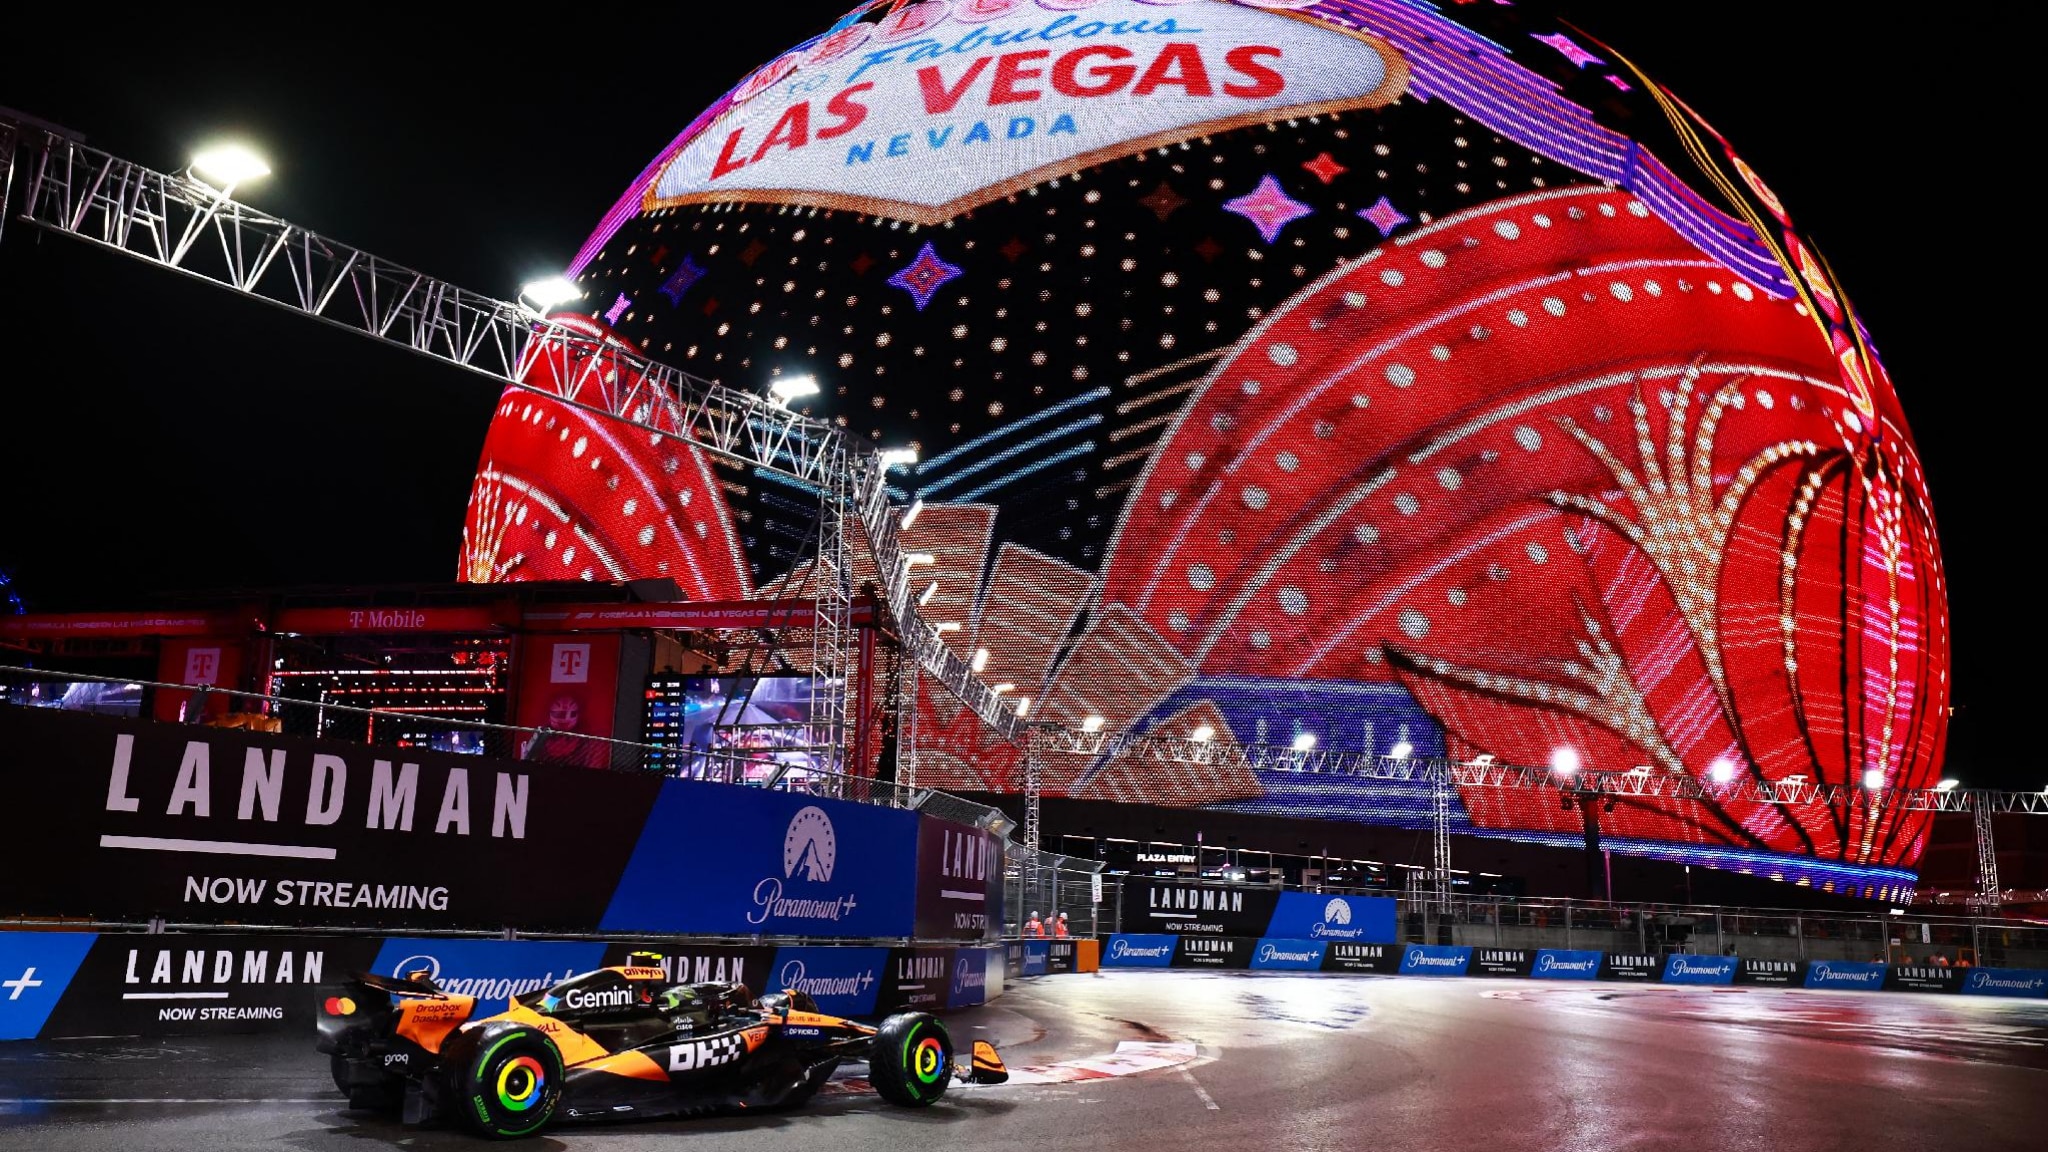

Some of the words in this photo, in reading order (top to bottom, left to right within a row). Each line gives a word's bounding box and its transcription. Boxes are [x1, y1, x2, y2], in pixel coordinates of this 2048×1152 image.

[845, 14, 1201, 84] Fabulous
[708, 81, 874, 181] LAS
[915, 42, 1286, 115] VEGAS
[844, 112, 1078, 166] NEVADA
[368, 608, 425, 629] Mobile
[701, 610, 720, 618] LAS
[721, 609, 756, 618] VEGAS
[106, 734, 529, 839] LANDMAN
[1136, 853, 1166, 863] PLAZA
[1167, 854, 1196, 864] ENTRY
[184, 876, 267, 905] NOW
[274, 879, 449, 911] STREAMING
[747, 877, 856, 924] Paramount+
[1150, 887, 1242, 912] LANDMAN
[1166, 922, 1183, 931] NOW
[1184, 923, 1224, 932] STREAMING
[1310, 922, 1364, 938] Paramount+
[1185, 940, 1233, 952] LANDMAN
[1259, 944, 1320, 963] Paramount+
[1335, 945, 1383, 957] LANDMAN
[1480, 950, 1524, 962] LANDMAN
[1610, 955, 1656, 967] LANDMAN
[124, 950, 324, 984] LANDMAN
[1671, 959, 1730, 976] Paramount+
[1746, 960, 1797, 972] LANDMAN
[1814, 965, 1879, 982] Paramount+
[1897, 967, 1952, 979] LANDMAN
[781, 959, 874, 996] Paramount+
[1972, 972, 2044, 989] Paramount+
[566, 984, 633, 1009] Gemini
[158, 1007, 196, 1021] NOW
[200, 1007, 283, 1021] STREAMING
[416, 1003, 461, 1013] Dropbox
[412, 1015, 439, 1023] Dash
[384, 1053, 409, 1066] groq
